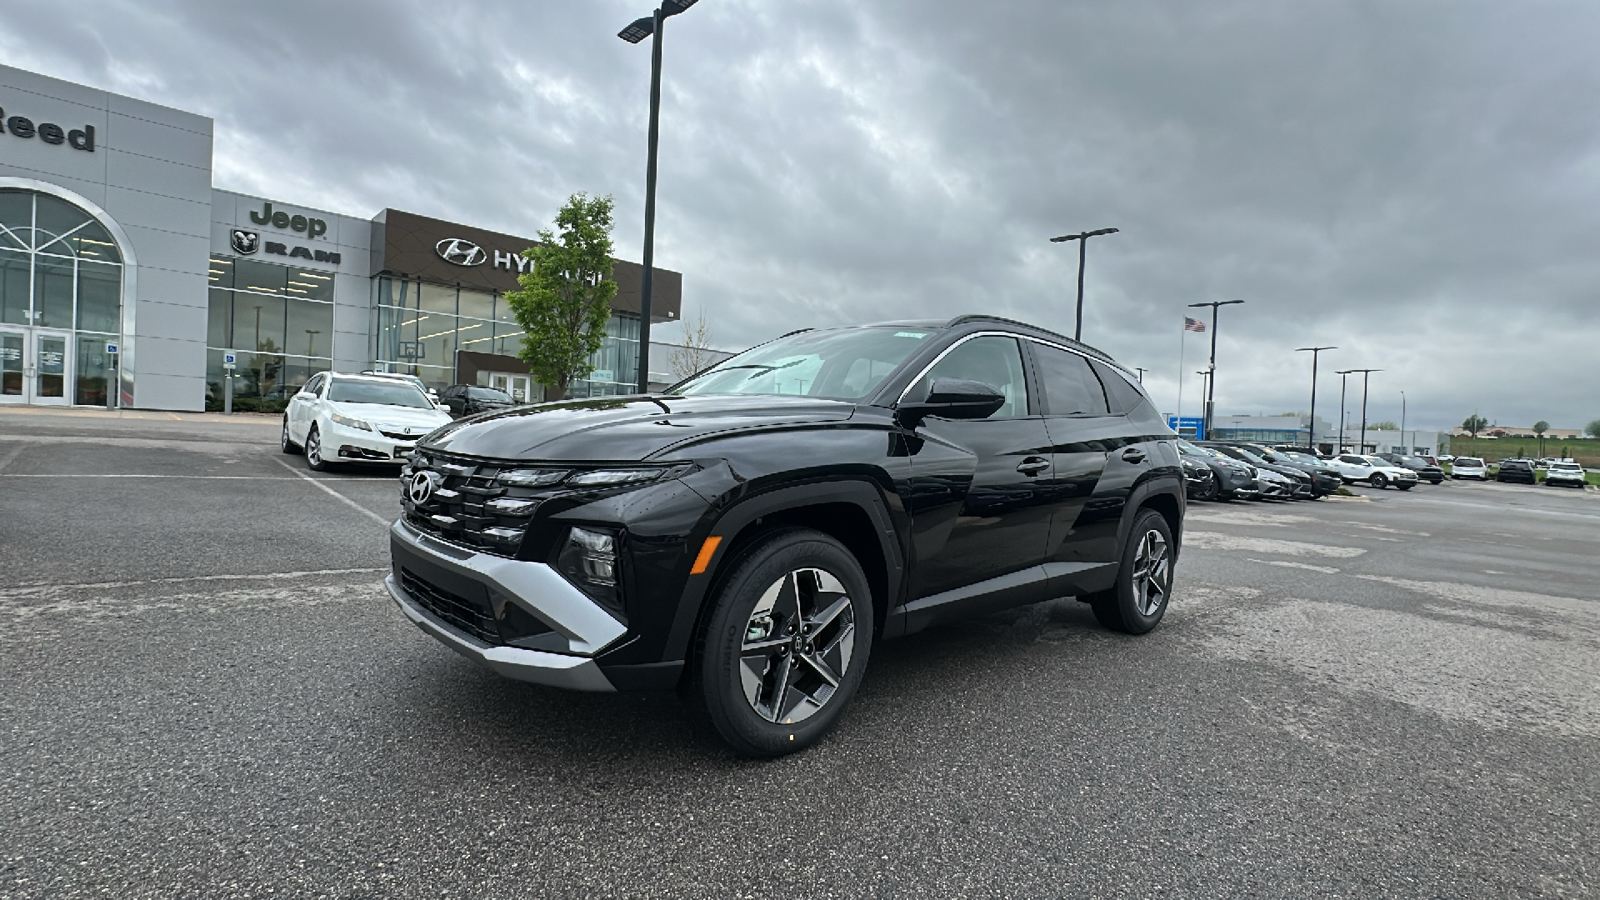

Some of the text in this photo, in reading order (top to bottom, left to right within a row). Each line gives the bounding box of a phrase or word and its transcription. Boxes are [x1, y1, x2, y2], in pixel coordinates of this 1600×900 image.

[0, 106, 95, 153] eed
[250, 202, 327, 239] Jeep
[265, 241, 341, 265] RAM
